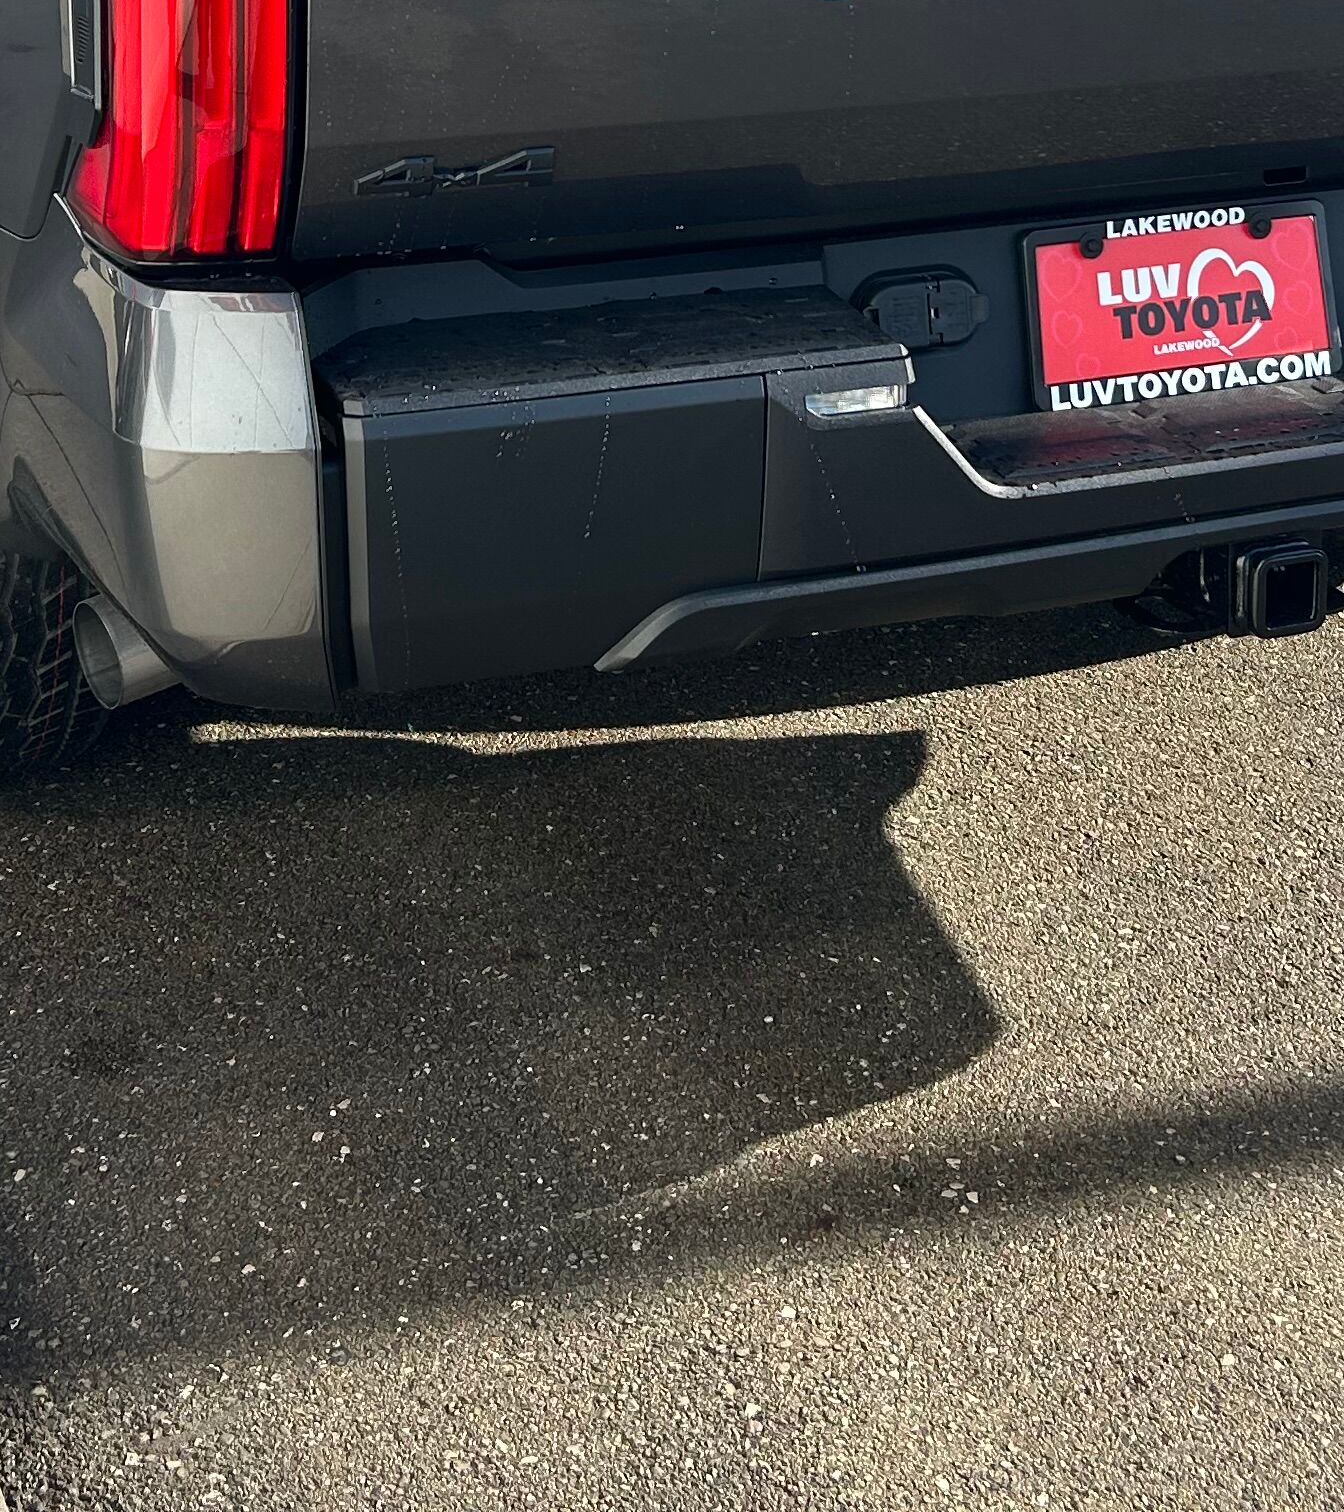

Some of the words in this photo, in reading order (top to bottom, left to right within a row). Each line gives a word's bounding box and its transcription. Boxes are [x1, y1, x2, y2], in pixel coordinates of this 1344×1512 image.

[1106, 206, 1246, 239] LAKEWOOD
[1096, 262, 1181, 306] LUV
[1113, 289, 1272, 339] TOYOTA
[1154, 337, 1221, 355] LAKEWOOD
[1050, 350, 1332, 412] LUVTOYOTA.COM
